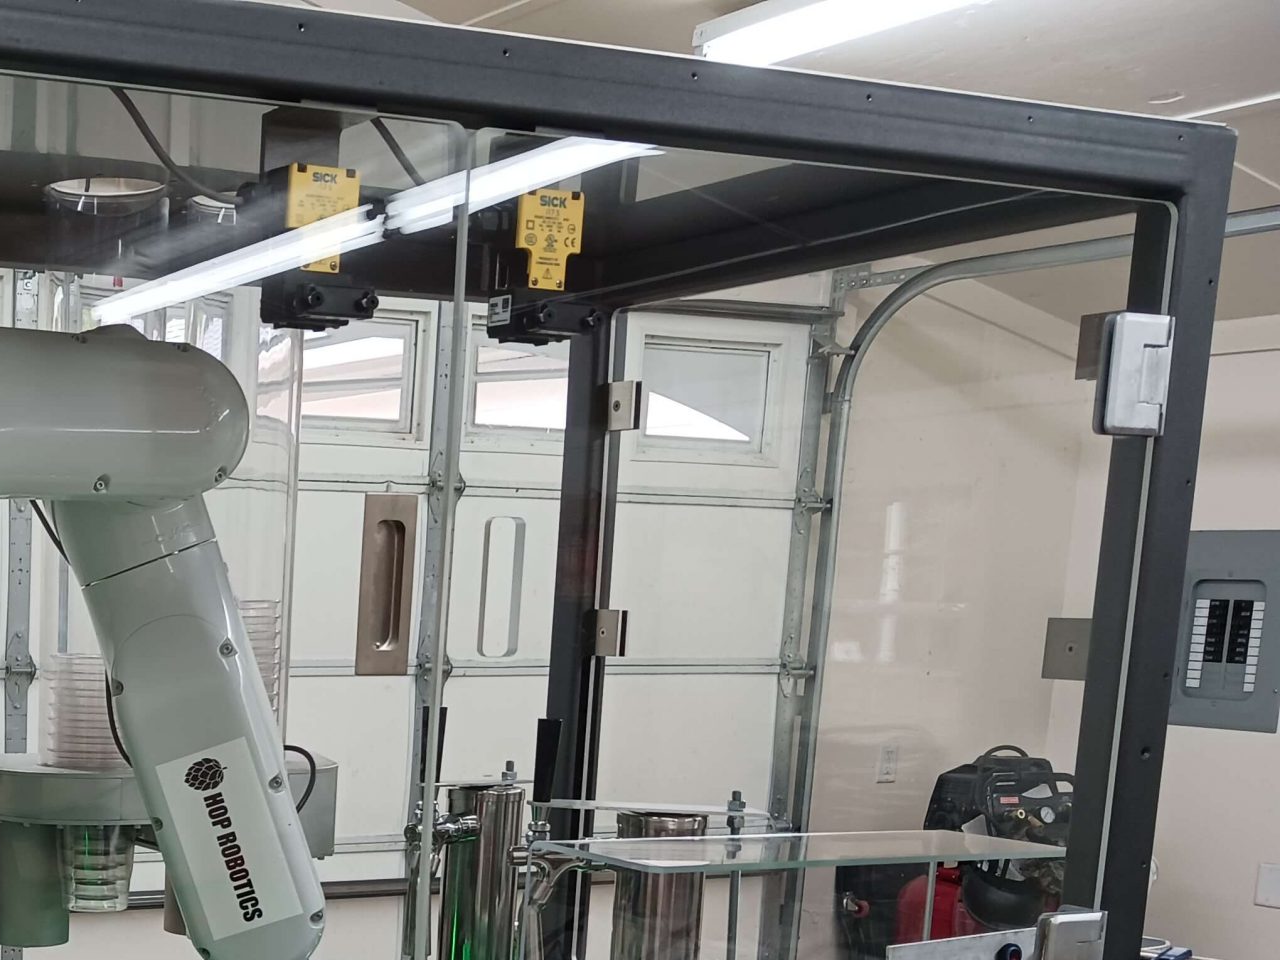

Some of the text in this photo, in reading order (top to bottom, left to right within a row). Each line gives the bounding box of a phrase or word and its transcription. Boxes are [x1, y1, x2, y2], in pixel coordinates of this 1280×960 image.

[312, 172, 337, 184] SICK
[539, 195, 567, 209] SICK
[203, 792, 263, 922] HOP ROBOTICS
